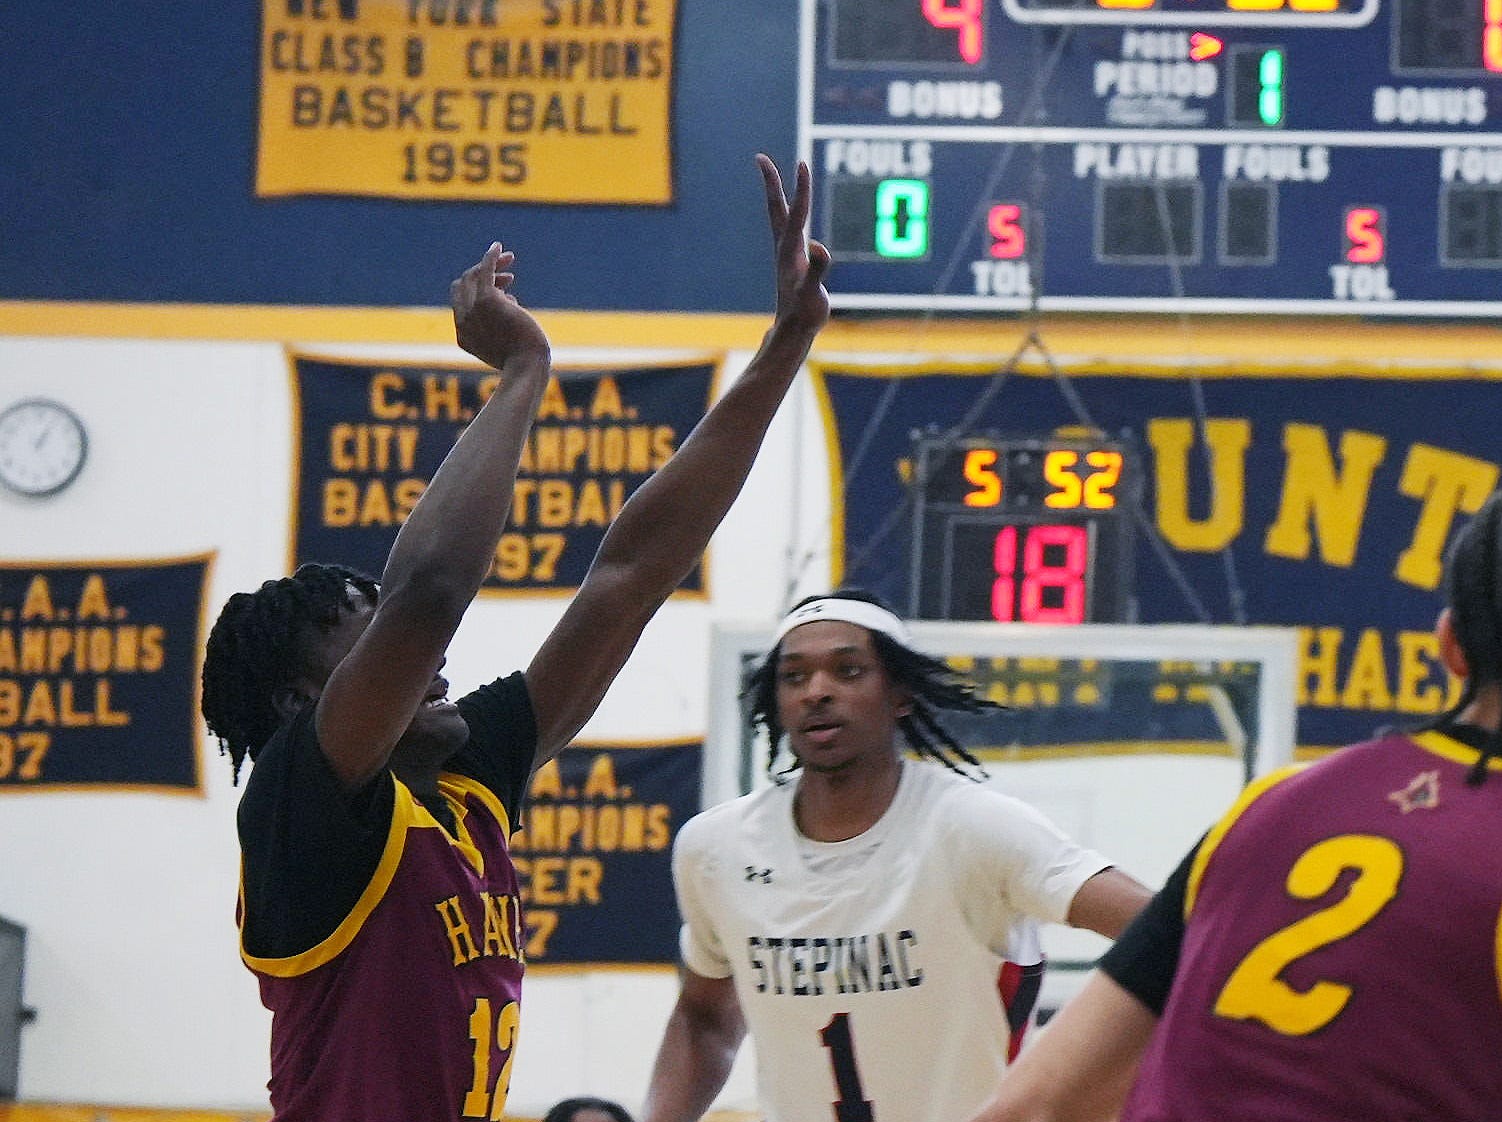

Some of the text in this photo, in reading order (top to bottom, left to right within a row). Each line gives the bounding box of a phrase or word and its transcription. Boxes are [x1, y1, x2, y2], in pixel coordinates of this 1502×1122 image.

[271, 29, 663, 80] CLASS B CHAMPIONS
[887, 81, 1001, 118] BONUS
[1093, 61, 1218, 98] PERIOD
[1259, 49, 1283, 126] 1
[293, 85, 637, 135] BASKETBALL
[1373, 86, 1488, 124] BONUS
[403, 141, 527, 184] 1995
[825, 140, 931, 176] FOULS
[1073, 142, 1330, 182] PLAYER FOULS
[875, 178, 929, 259] 0
[988, 204, 1025, 258] 5
[1346, 208, 1384, 263] 5
[971, 261, 1032, 295] TOL
[1328, 264, 1396, 300] TOL
[330, 424, 418, 472] CITY
[1146, 418, 1500, 590] UNT
[497, 534, 566, 581] 97
[991, 524, 1088, 625] 18
[1213, 833, 1404, 1036] 2
[749, 930, 924, 996] STEPINAC
